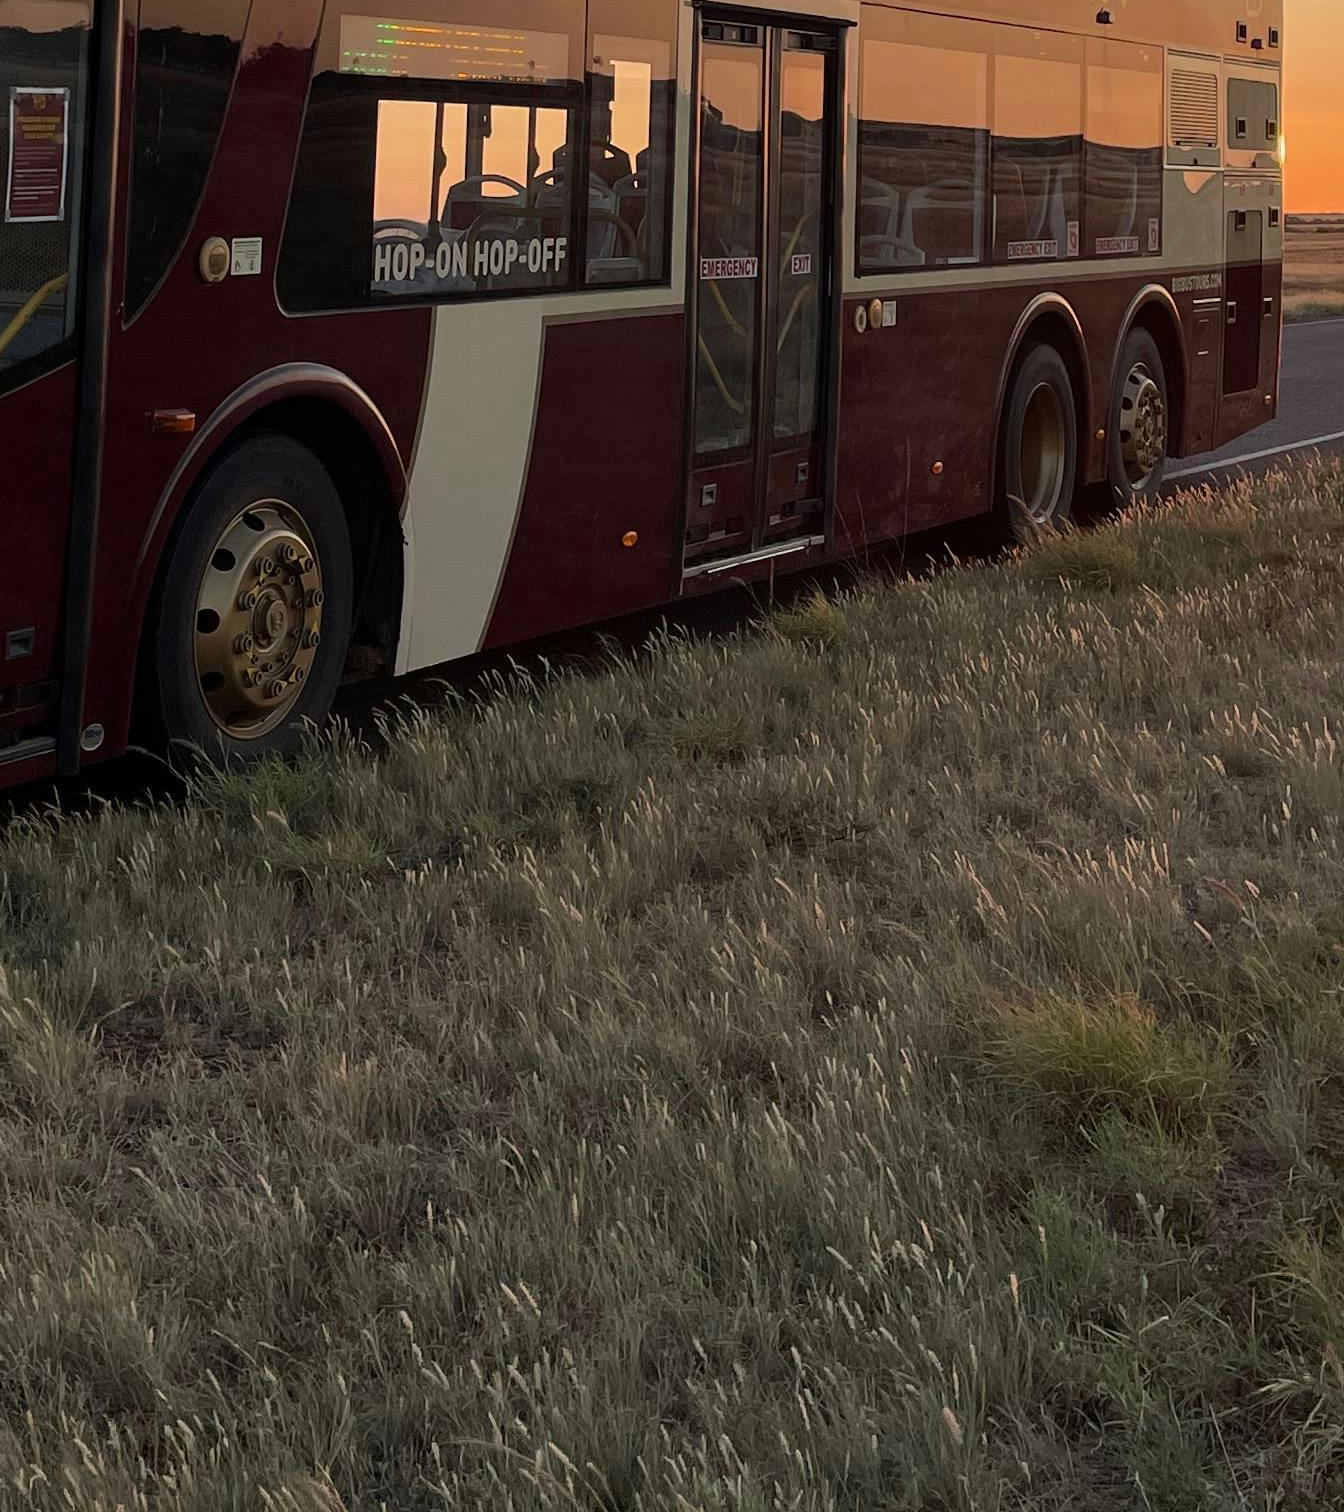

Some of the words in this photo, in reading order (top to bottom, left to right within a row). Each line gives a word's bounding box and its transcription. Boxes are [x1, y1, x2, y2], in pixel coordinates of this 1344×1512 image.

[374, 241, 468, 282] HOP-ON
[473, 237, 567, 276] HOP-OFF
[702, 259, 756, 277] EMERGENCY
[793, 257, 810, 273] EXIT
